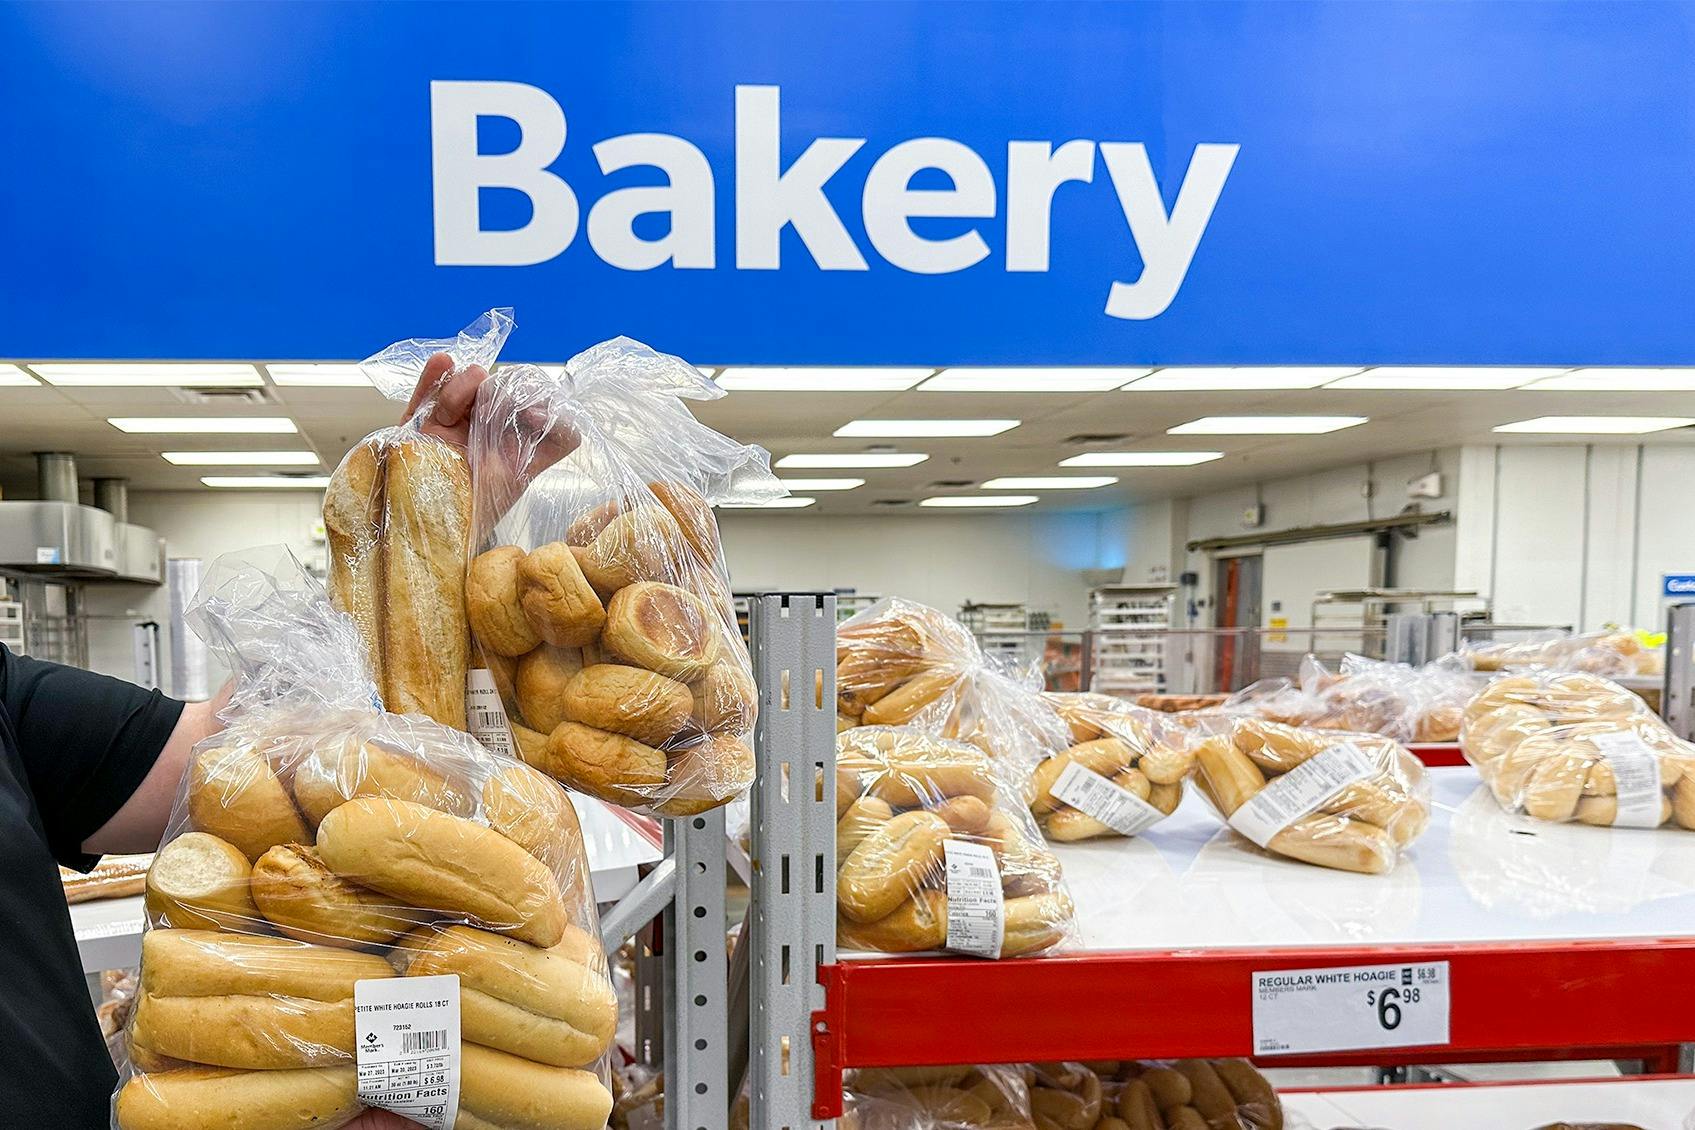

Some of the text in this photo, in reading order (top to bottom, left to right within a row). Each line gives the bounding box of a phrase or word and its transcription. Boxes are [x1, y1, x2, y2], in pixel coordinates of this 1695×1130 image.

[430, 79, 1241, 320] Bakery
[1258, 970, 1396, 987] REGULAR WHITE HOAGIE
[374, 1004, 392, 1012] WHITE
[393, 1002, 414, 1010] HOAGIE
[416, 1087, 448, 1098] Facts
[424, 1106, 443, 1115] 160
